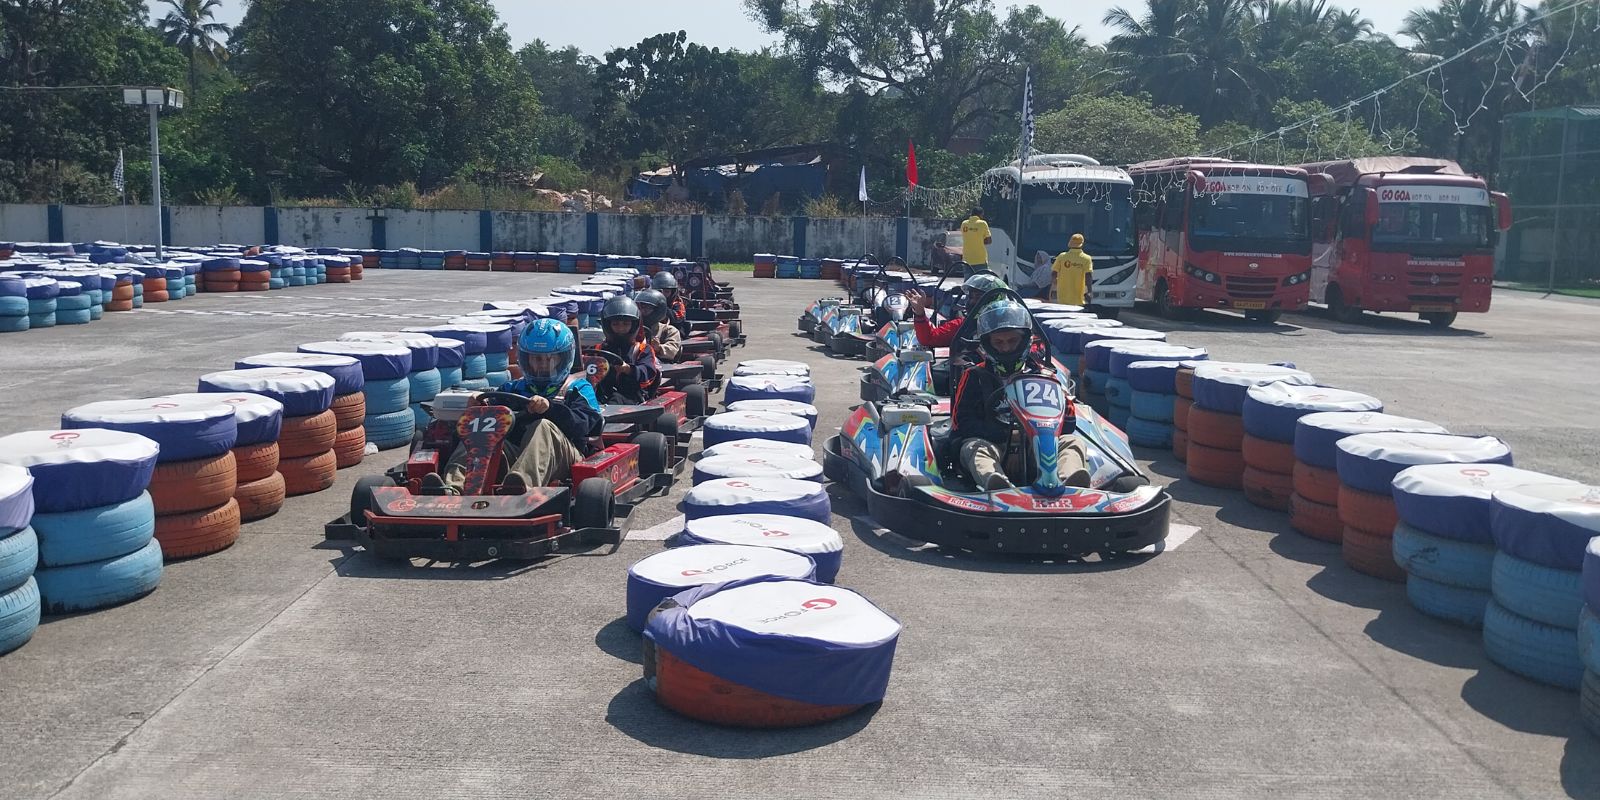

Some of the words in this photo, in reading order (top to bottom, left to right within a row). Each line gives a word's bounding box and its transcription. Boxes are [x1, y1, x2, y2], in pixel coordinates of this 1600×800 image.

[1382, 189, 1393, 201] GO
[1394, 190, 1410, 201] GOA
[586, 364, 597, 375] 6
[1025, 382, 1058, 406] 24
[469, 417, 497, 433] 12
